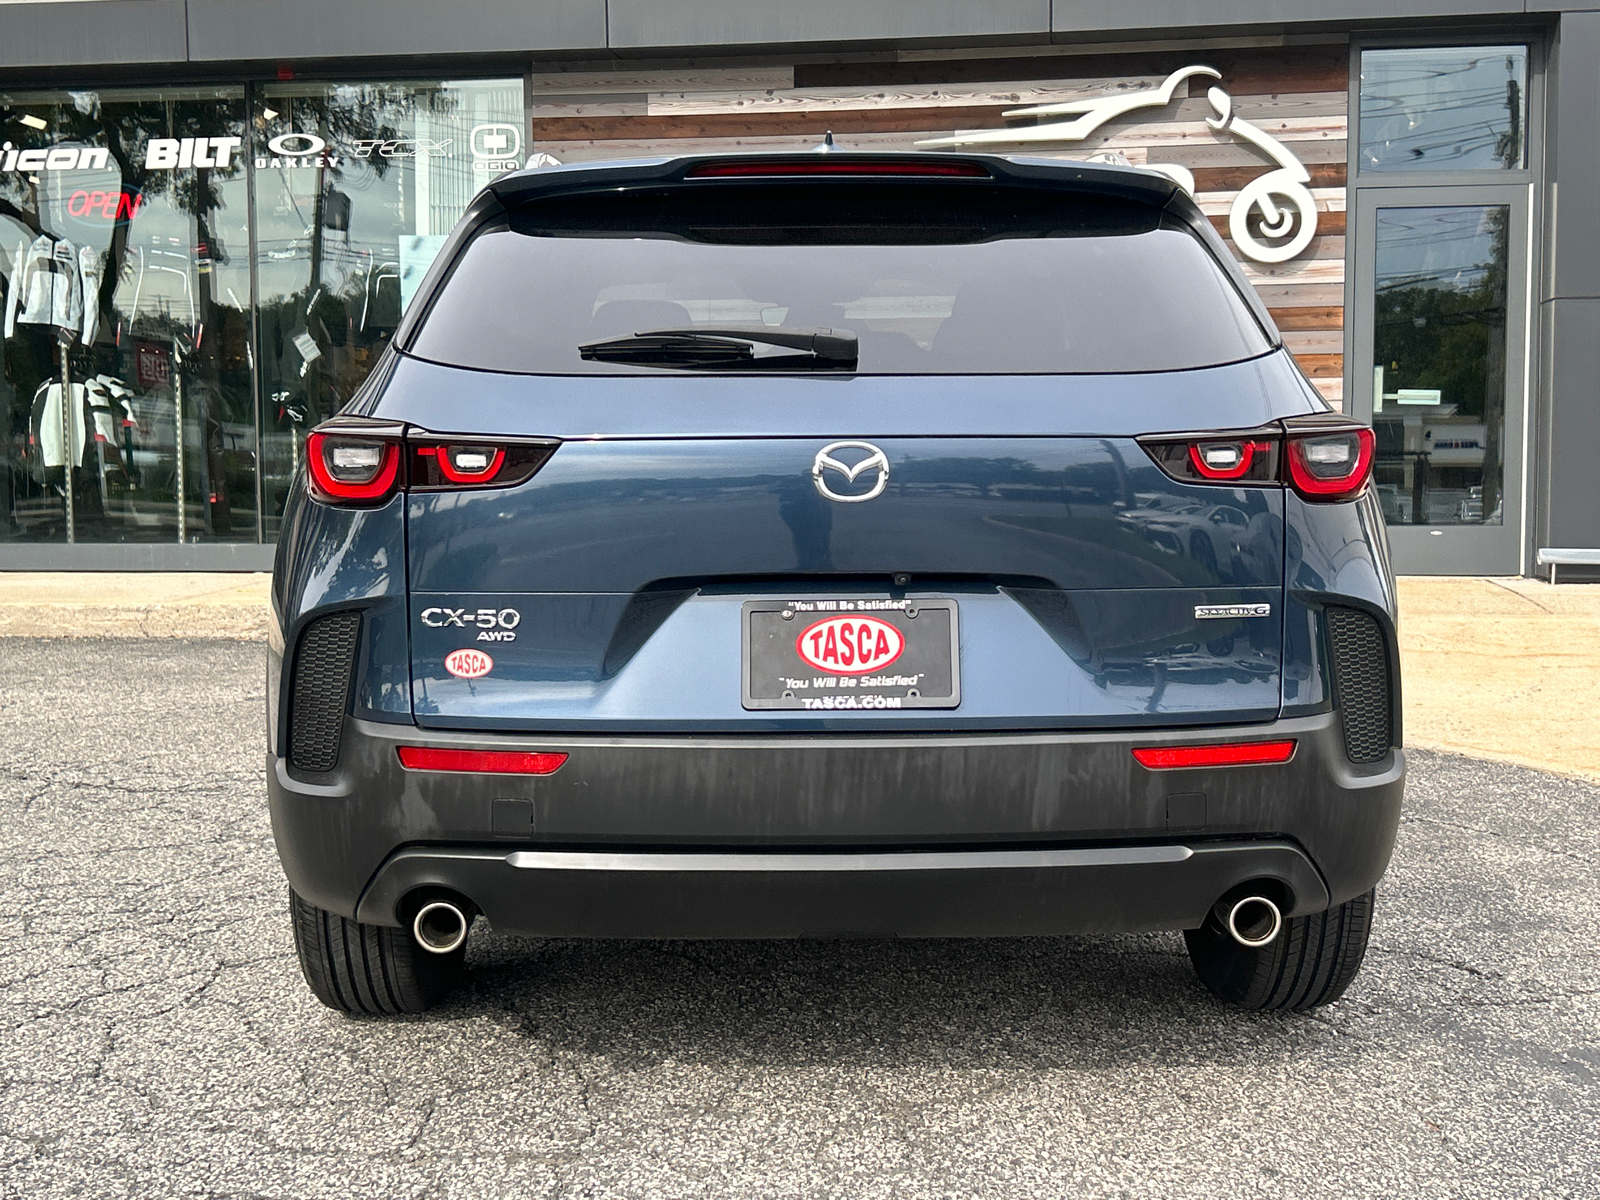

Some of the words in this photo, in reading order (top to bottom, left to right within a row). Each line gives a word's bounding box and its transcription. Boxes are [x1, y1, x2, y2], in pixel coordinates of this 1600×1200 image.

[145, 136, 241, 170] BILT
[255, 157, 340, 169] OAKLEY
[473, 159, 520, 172] OGIO
[67, 190, 142, 220] OPEN
[817, 601, 837, 611] Will
[839, 601, 855, 611] Be
[420, 607, 521, 629] CX-50
[476, 631, 517, 642] AWD
[809, 622, 891, 667] TASCA
[451, 653, 487, 675] TASCA
[813, 677, 836, 688] Will
[839, 676, 857, 687] Be
[801, 697, 902, 709] TASCA.COM
